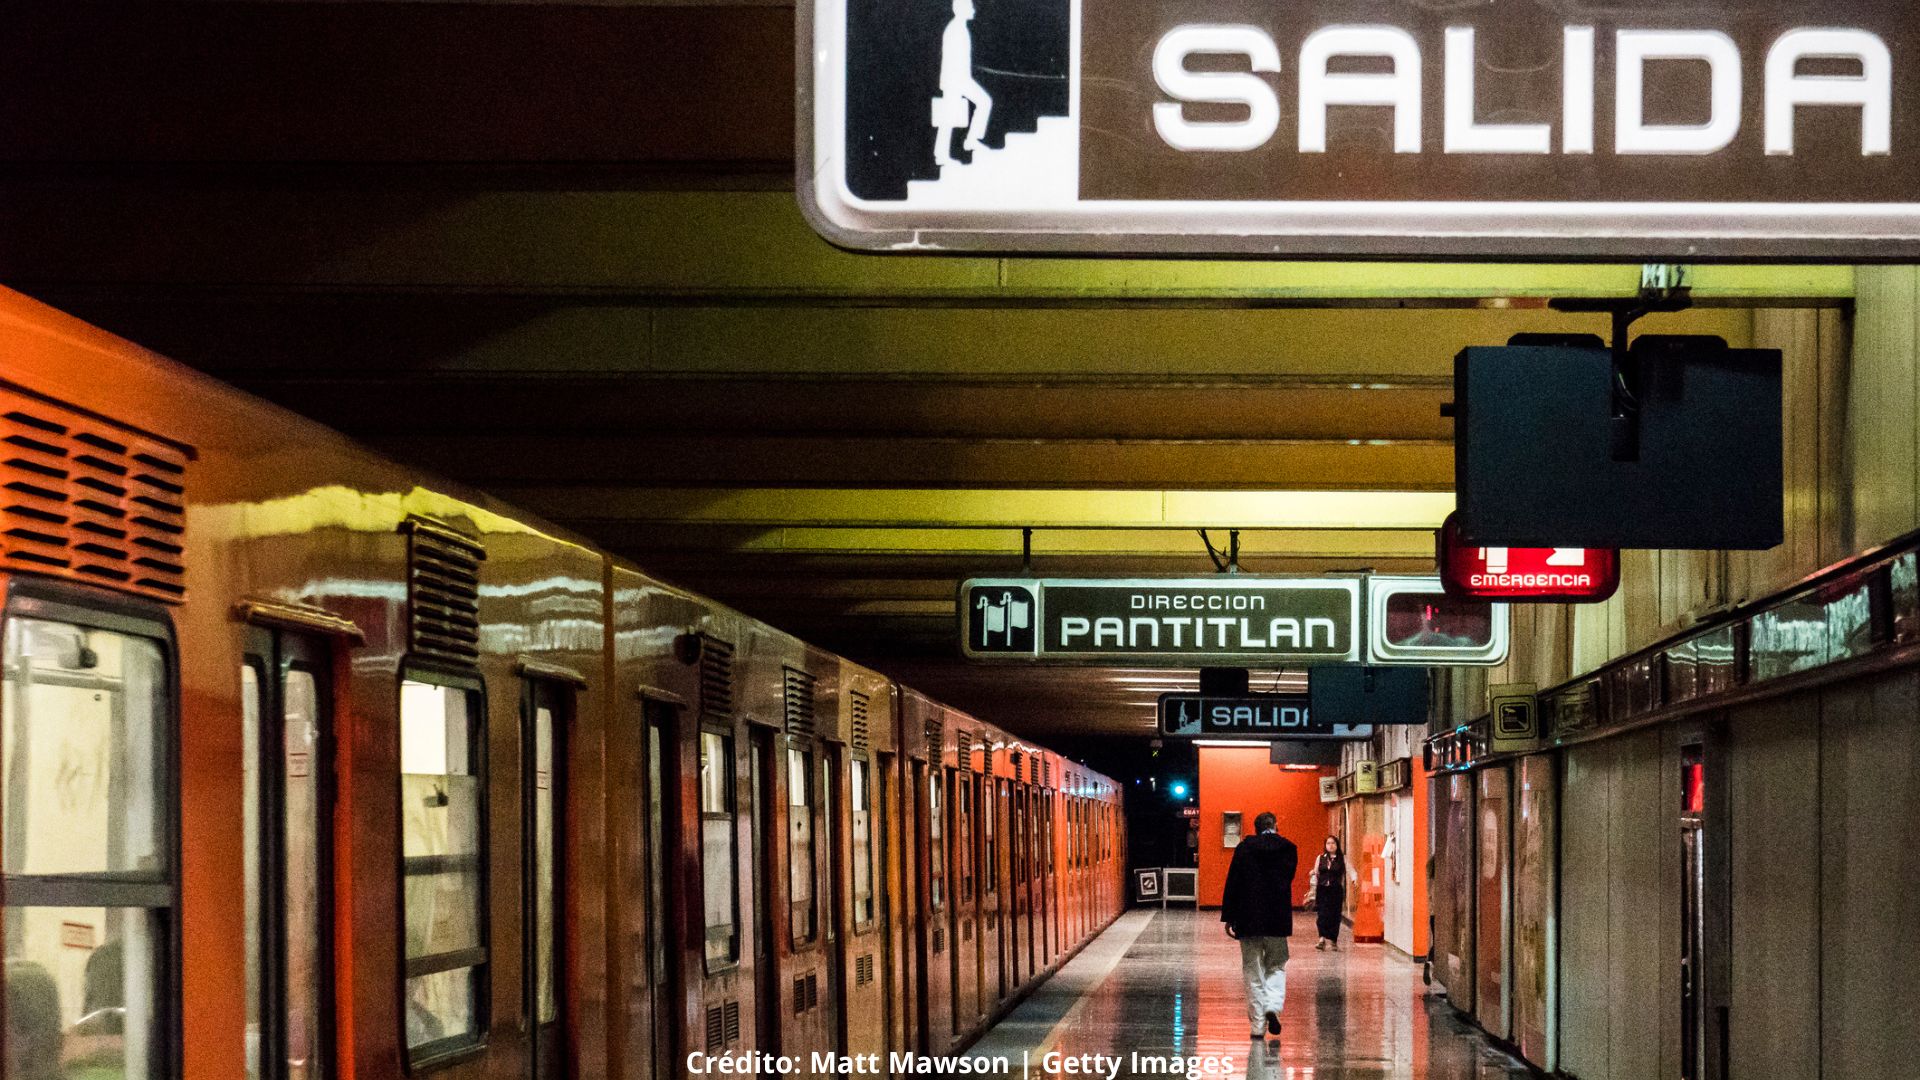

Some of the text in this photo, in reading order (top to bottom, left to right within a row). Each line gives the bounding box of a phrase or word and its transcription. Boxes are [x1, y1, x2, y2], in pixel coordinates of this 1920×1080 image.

[1152, 24, 1893, 157] SALIDA
[1470, 574, 1591, 587] EMERGENCIA
[1131, 595, 1265, 610] DIRECCION
[1061, 617, 1335, 648] PANTITLAN
